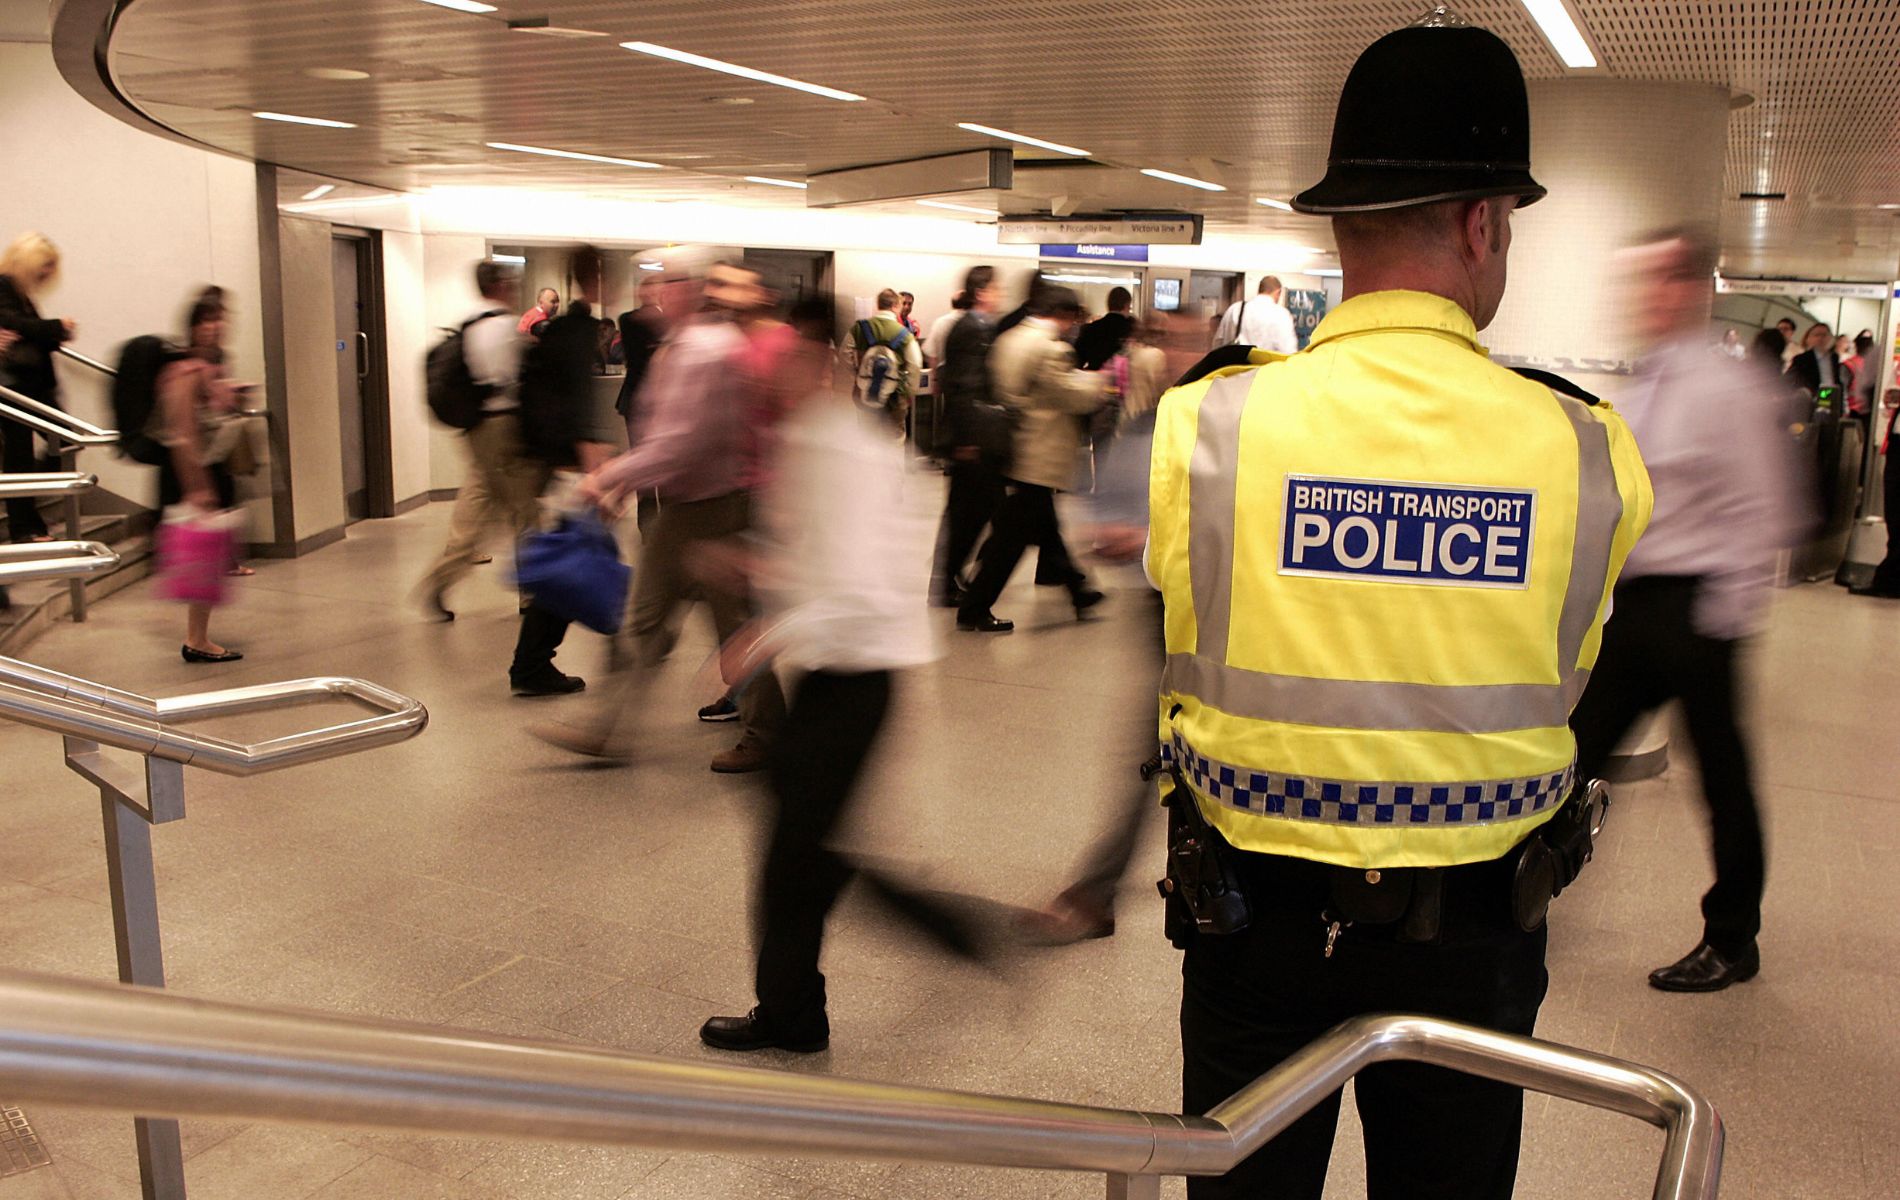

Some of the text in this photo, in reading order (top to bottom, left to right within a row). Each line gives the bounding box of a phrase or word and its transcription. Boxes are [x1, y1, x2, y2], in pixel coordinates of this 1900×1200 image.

[1066, 224, 1112, 234] Piccadilly line
[1131, 224, 1176, 233] Victoria line
[1076, 244, 1116, 256] Assistance
[1294, 486, 1526, 523] BRITISH TRANSPORT
[1291, 513, 1522, 577] POLICE
